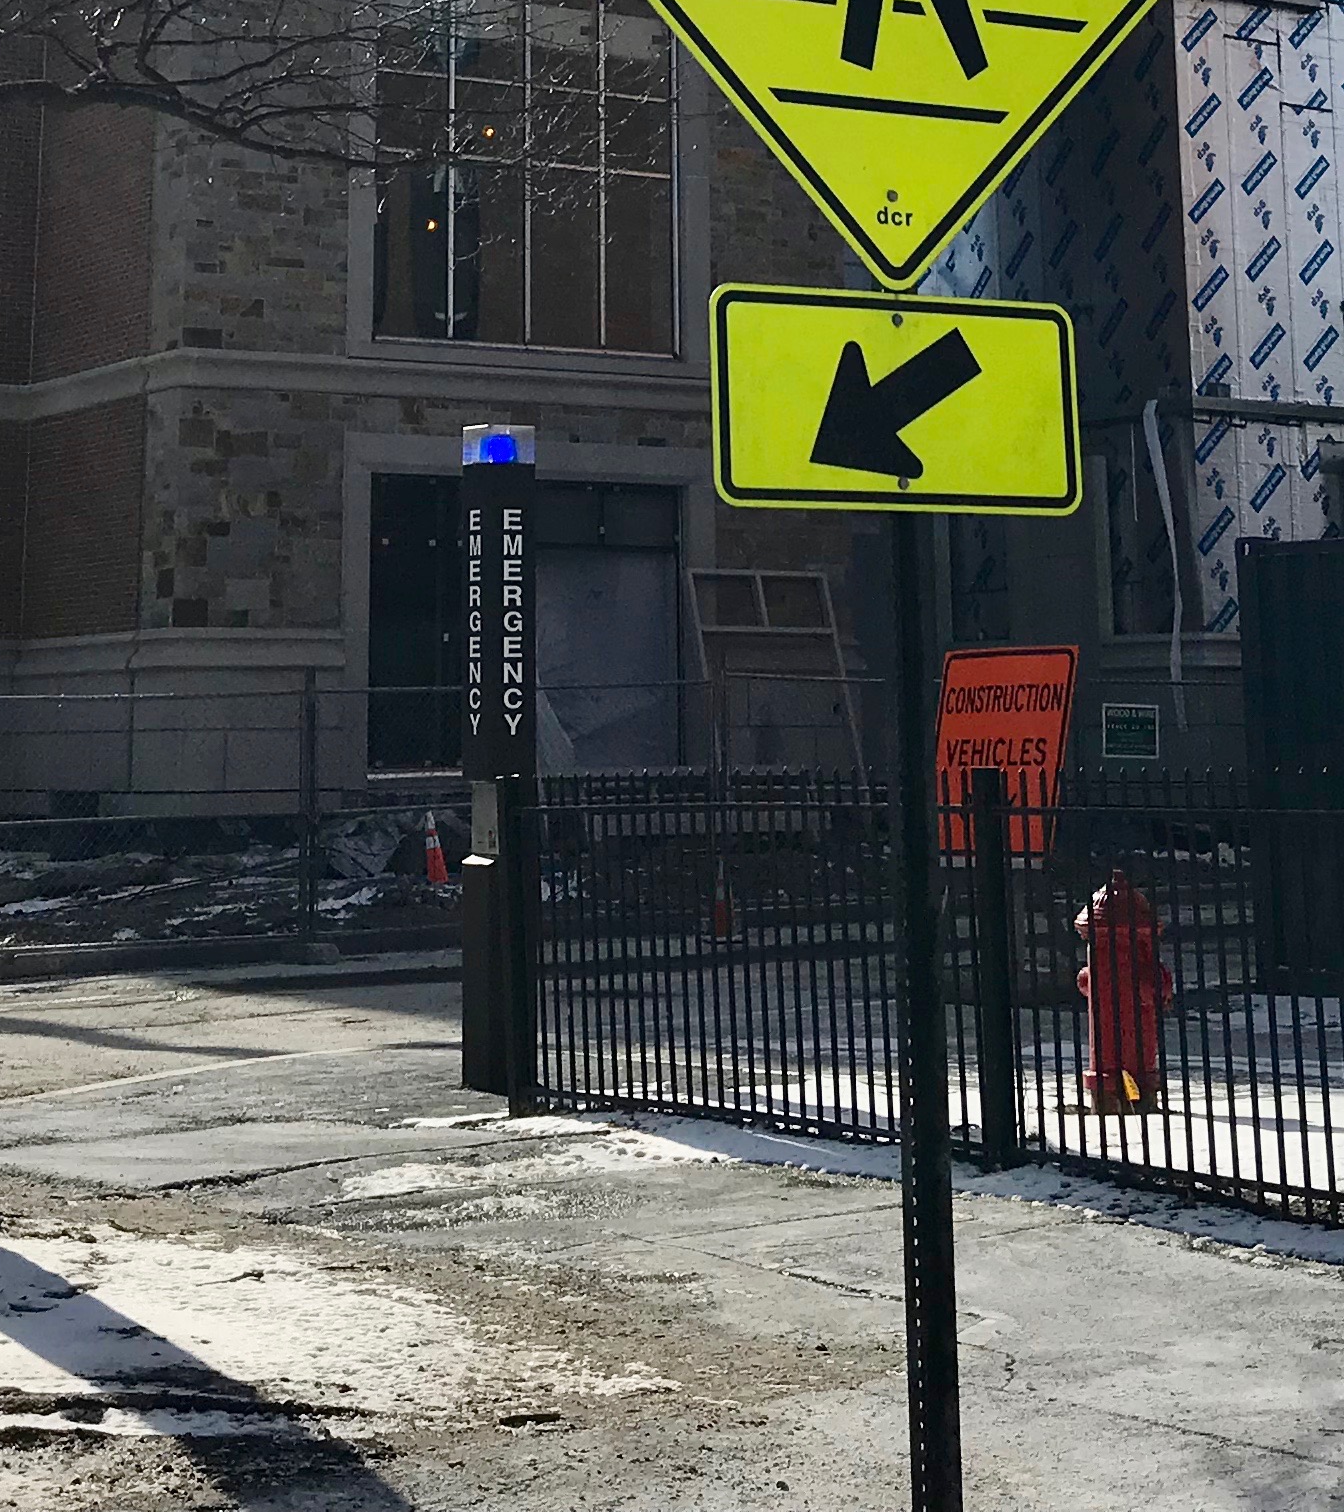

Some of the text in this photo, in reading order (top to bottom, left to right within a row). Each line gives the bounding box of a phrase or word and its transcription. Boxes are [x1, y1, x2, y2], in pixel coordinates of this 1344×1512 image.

[877, 206, 913, 226] dcr
[469, 509, 482, 736] EMERGENCY
[503, 509, 523, 736] EMERGENCY
[946, 683, 1065, 714] CONSTRUCTION
[947, 738, 1047, 767] VEHICLES
